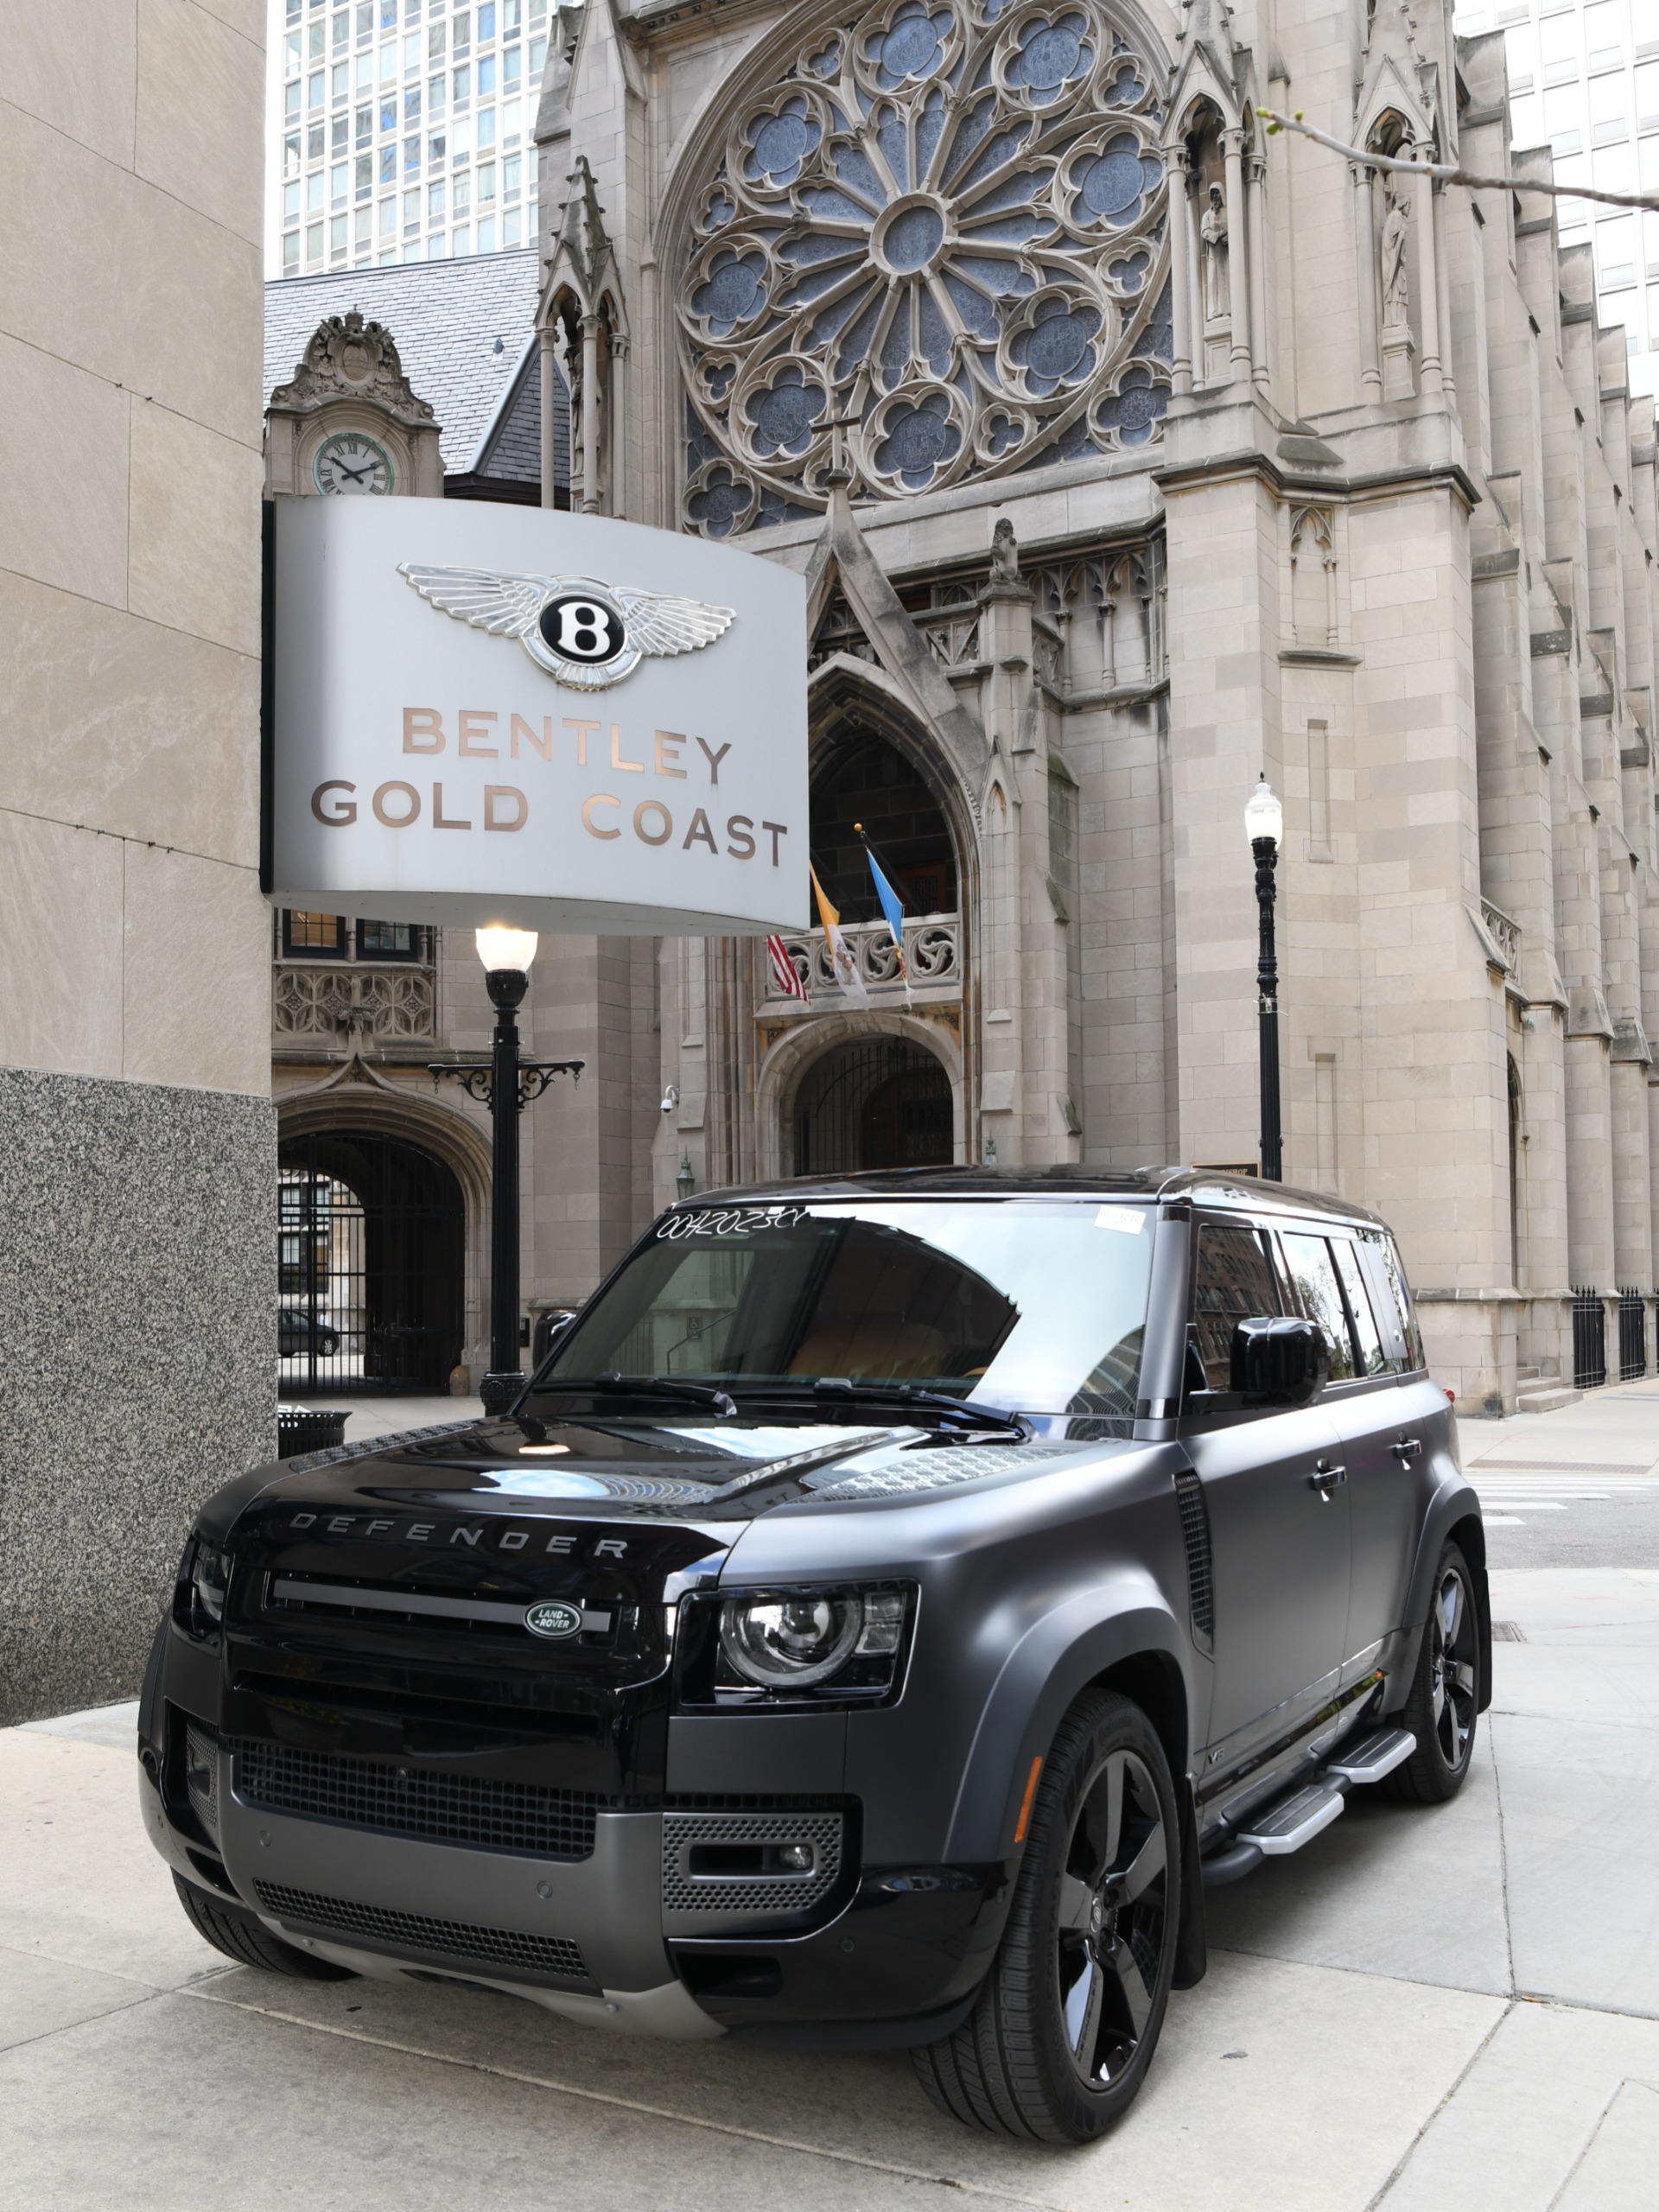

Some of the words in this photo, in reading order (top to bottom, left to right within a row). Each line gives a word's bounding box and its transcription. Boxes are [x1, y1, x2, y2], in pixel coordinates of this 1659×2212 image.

[556, 601, 611, 657] B
[402, 707, 733, 785] BENTLEY
[310, 779, 529, 833] GOLD
[581, 793, 789, 868] COAST
[289, 1512, 629, 1559] DEFENDER
